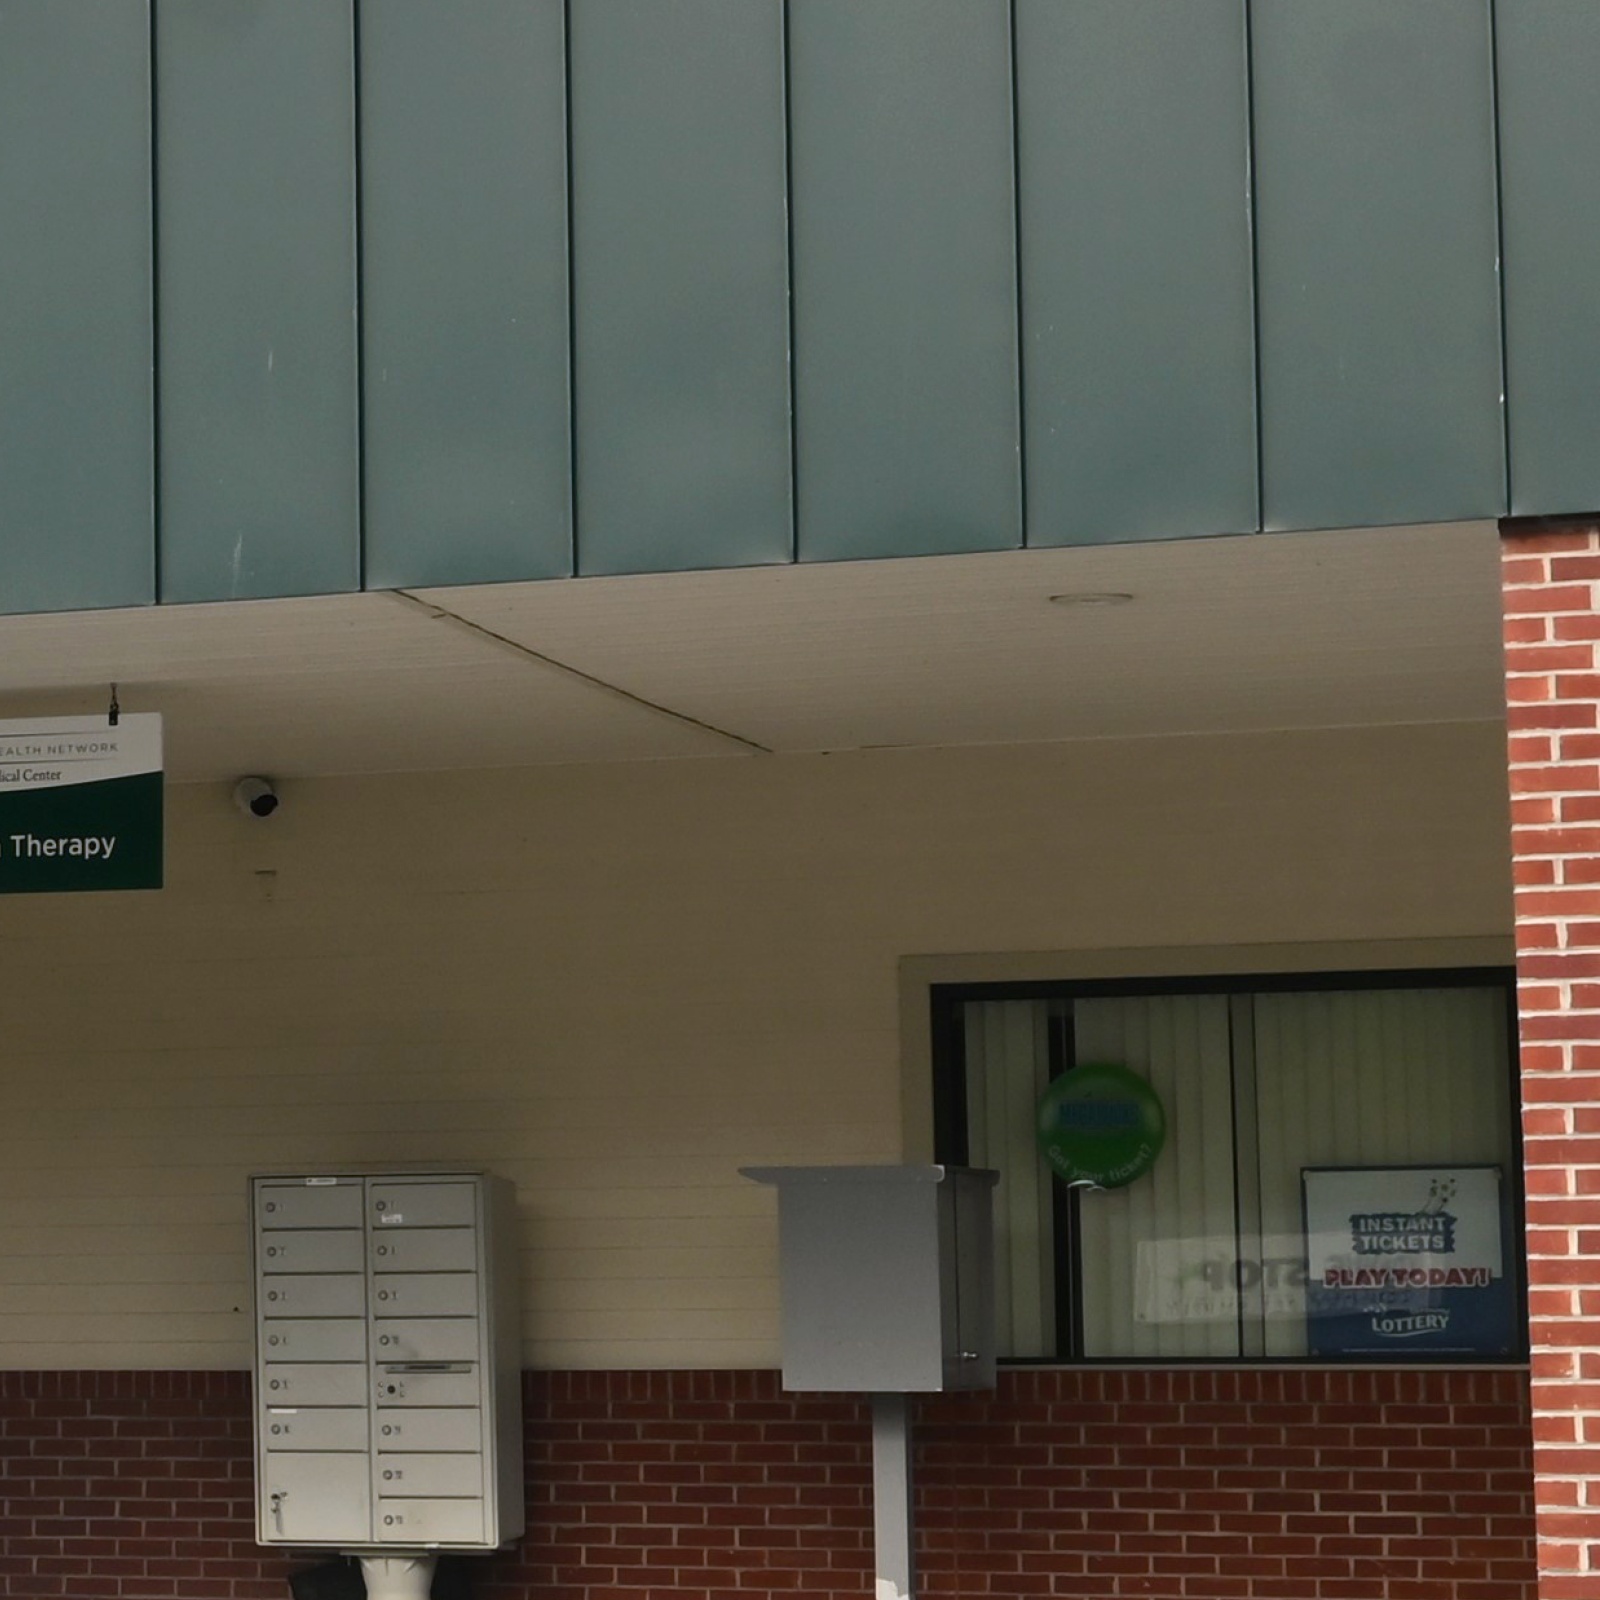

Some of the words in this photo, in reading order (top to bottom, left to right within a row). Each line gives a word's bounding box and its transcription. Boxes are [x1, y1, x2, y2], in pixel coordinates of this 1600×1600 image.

[47, 742, 119, 755] NETWORK
[23, 768, 63, 781] Center
[10, 834, 116, 860] Therapy
[1048, 1144, 1071, 1169] Got
[1108, 1142, 1153, 1181] ticket?
[1360, 1217, 1446, 1232] INSTANT
[1360, 1235, 1445, 1251] TICKETS
[1324, 1268, 1386, 1288] PLAY
[1391, 1268, 1491, 1288] TODAY!
[1371, 1313, 1450, 1333] LOTTERY
